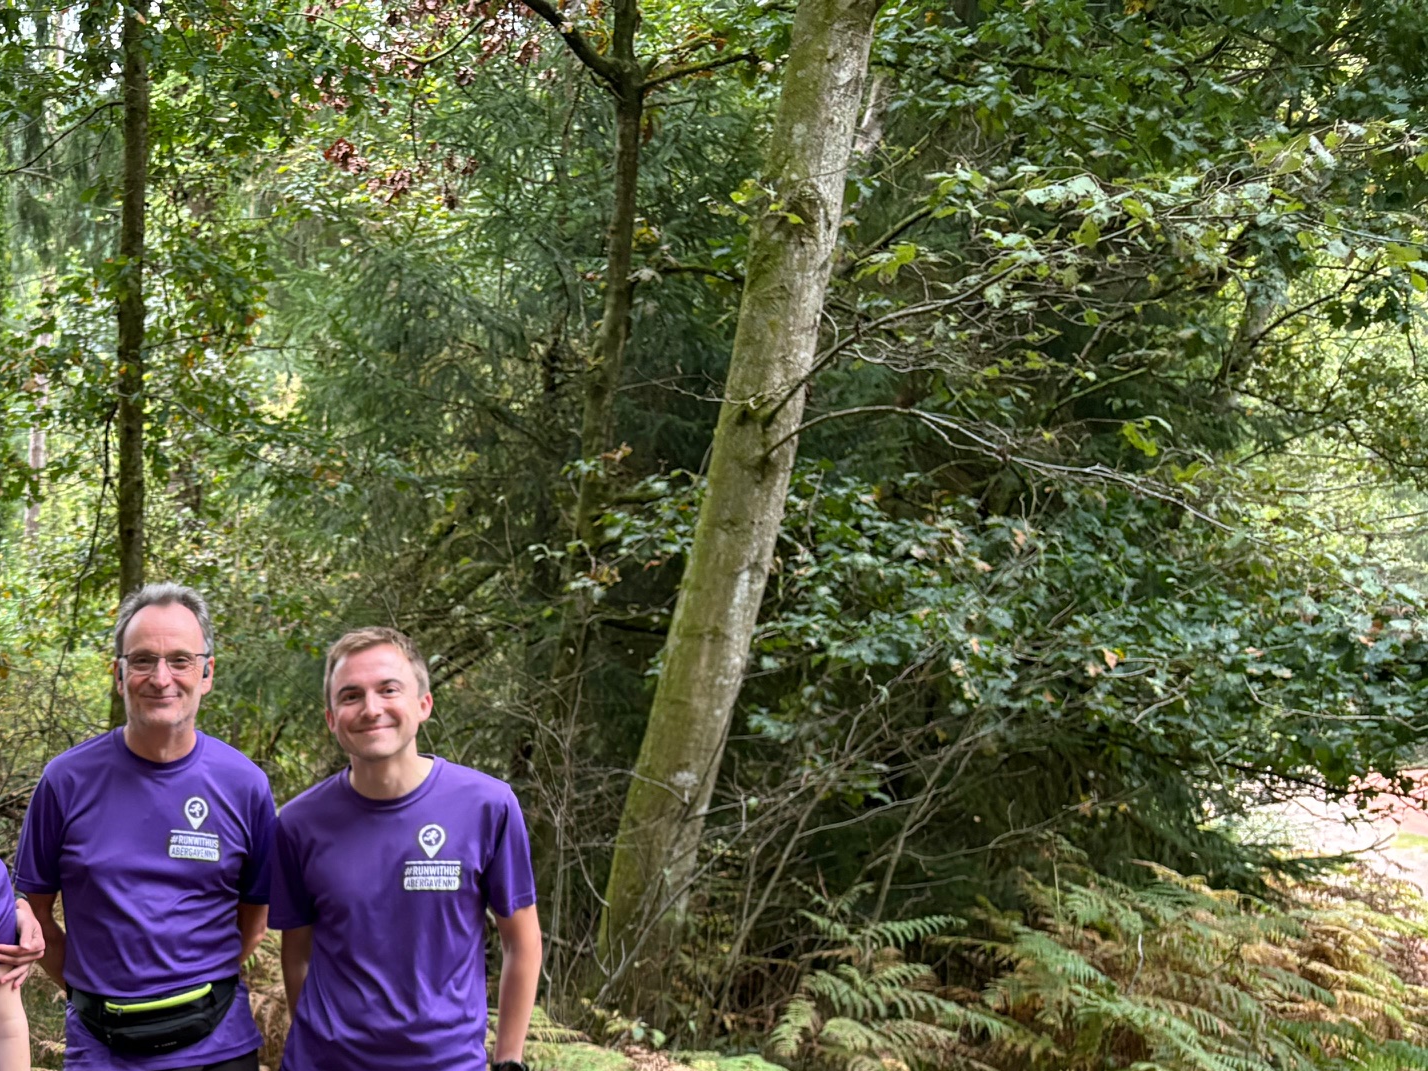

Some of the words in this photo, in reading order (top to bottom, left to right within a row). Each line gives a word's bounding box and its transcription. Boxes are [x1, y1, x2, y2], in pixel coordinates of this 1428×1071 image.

[171, 834, 219, 849] #RUNWITHUS
[171, 847, 217, 859] ABERGAVENNY
[405, 865, 460, 876] #RUNWITHUS
[406, 877, 456, 888] ABERGAVENNY
